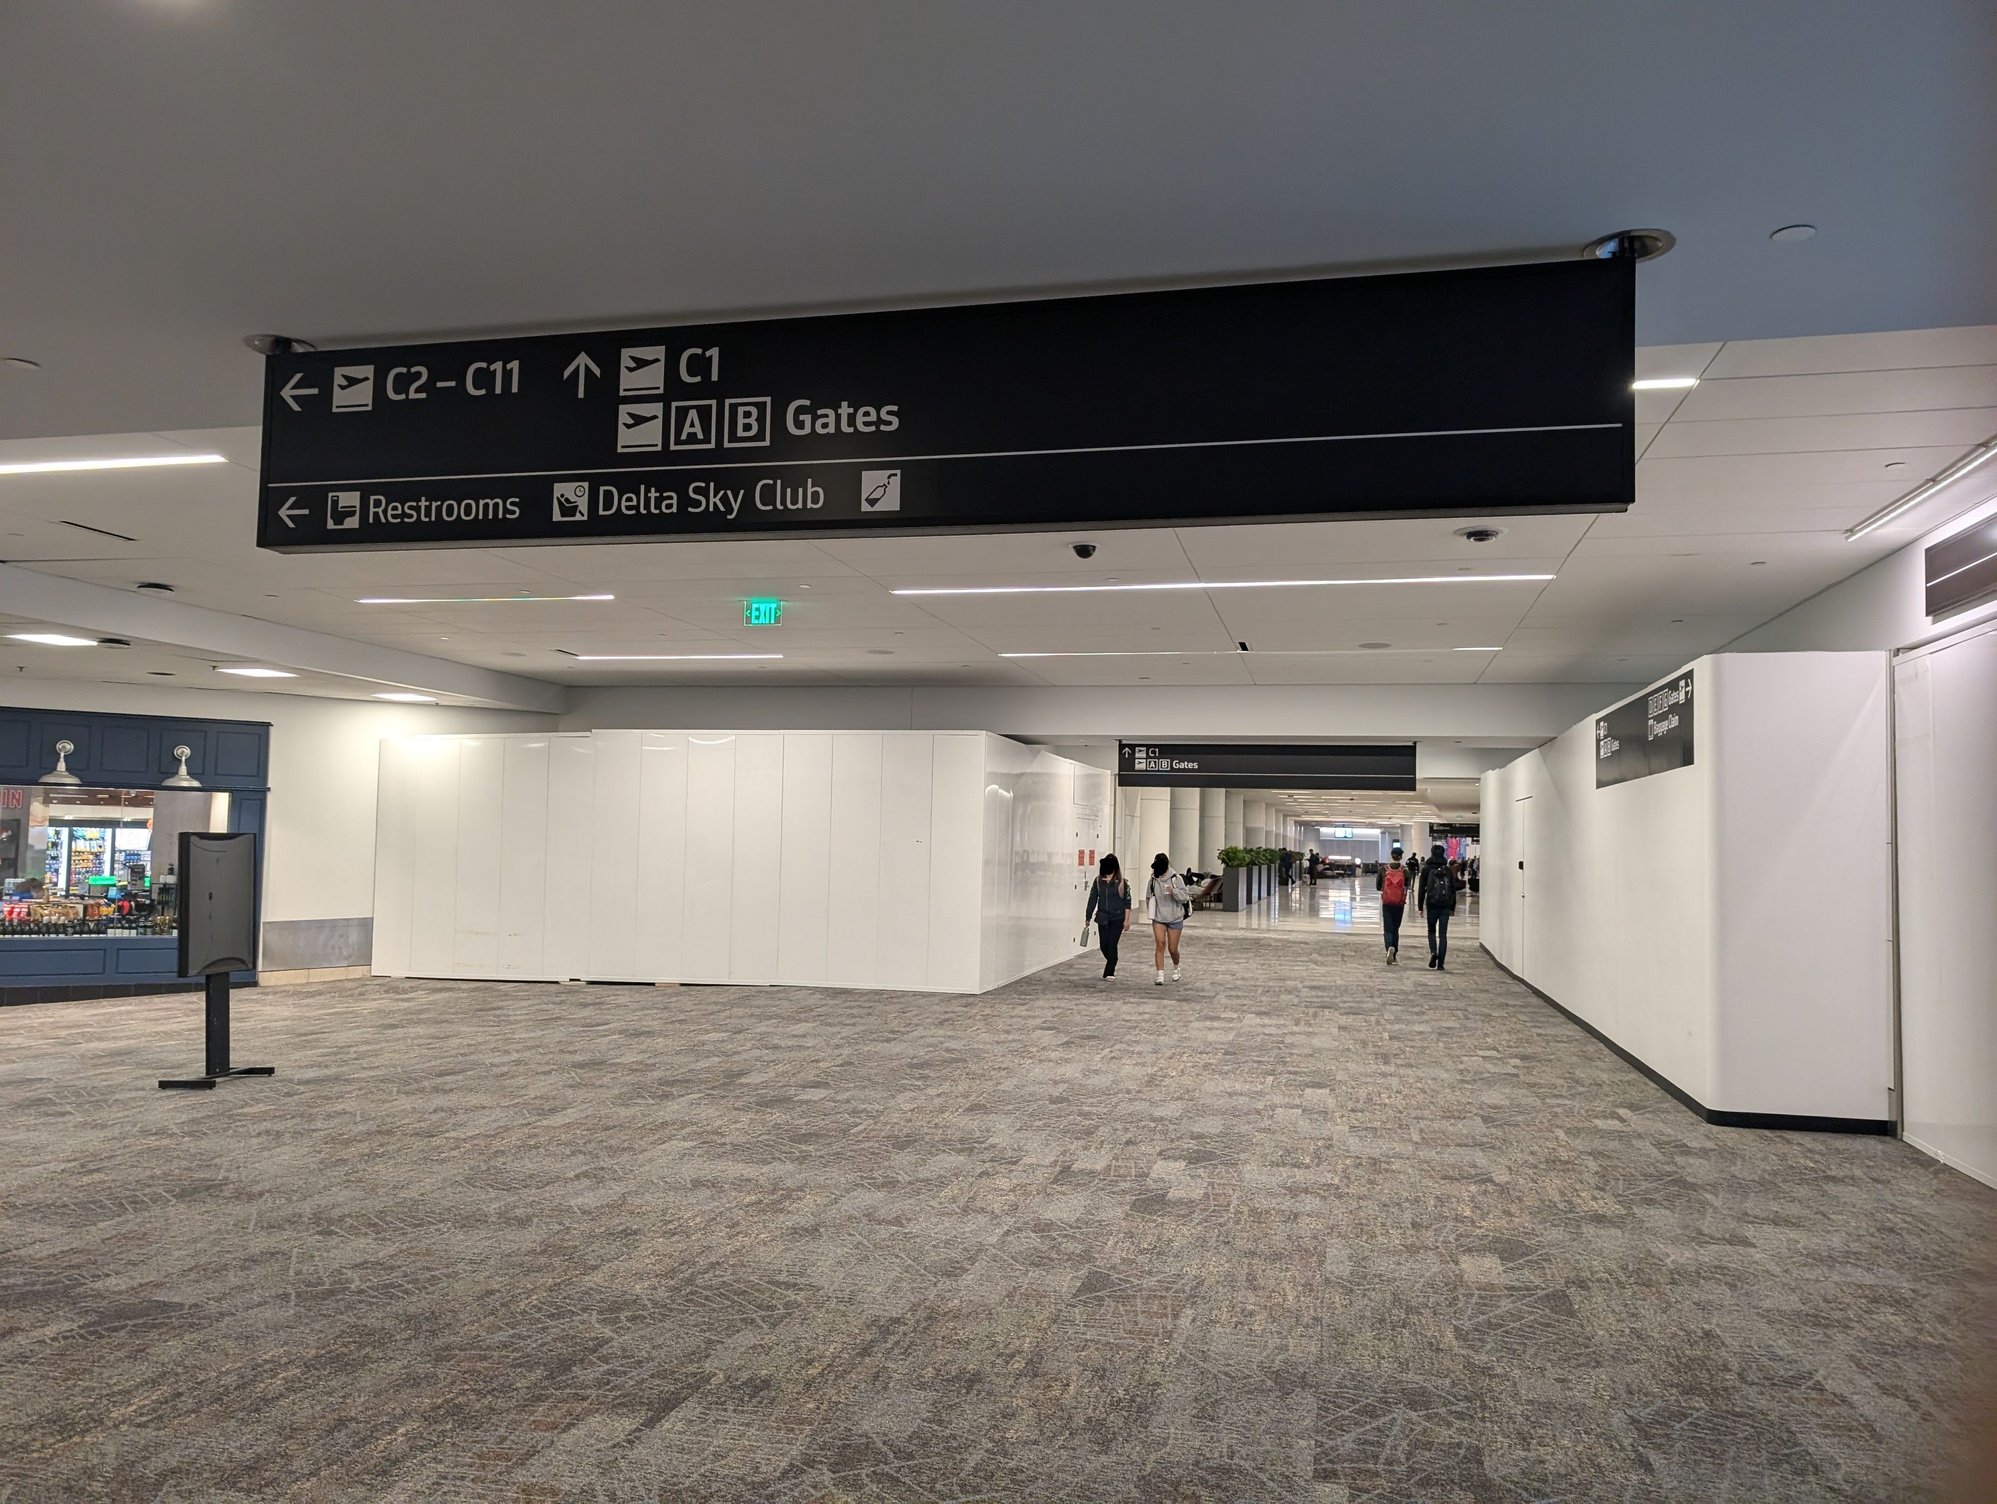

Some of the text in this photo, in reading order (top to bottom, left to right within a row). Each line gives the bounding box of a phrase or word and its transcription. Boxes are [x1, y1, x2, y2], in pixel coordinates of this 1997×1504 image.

[678, 346, 721, 384] C1
[386, 365, 428, 402] C2
[464, 359, 521, 398] C11
[680, 399, 900, 440] A B Gates
[368, 479, 825, 525] Restrooms Delta Sky Club
[751, 603, 777, 623] EXIT
[1654, 713, 1678, 736] Baggage Claim
[1149, 748, 1159, 756] C1
[1172, 760, 1199, 769] Gates
